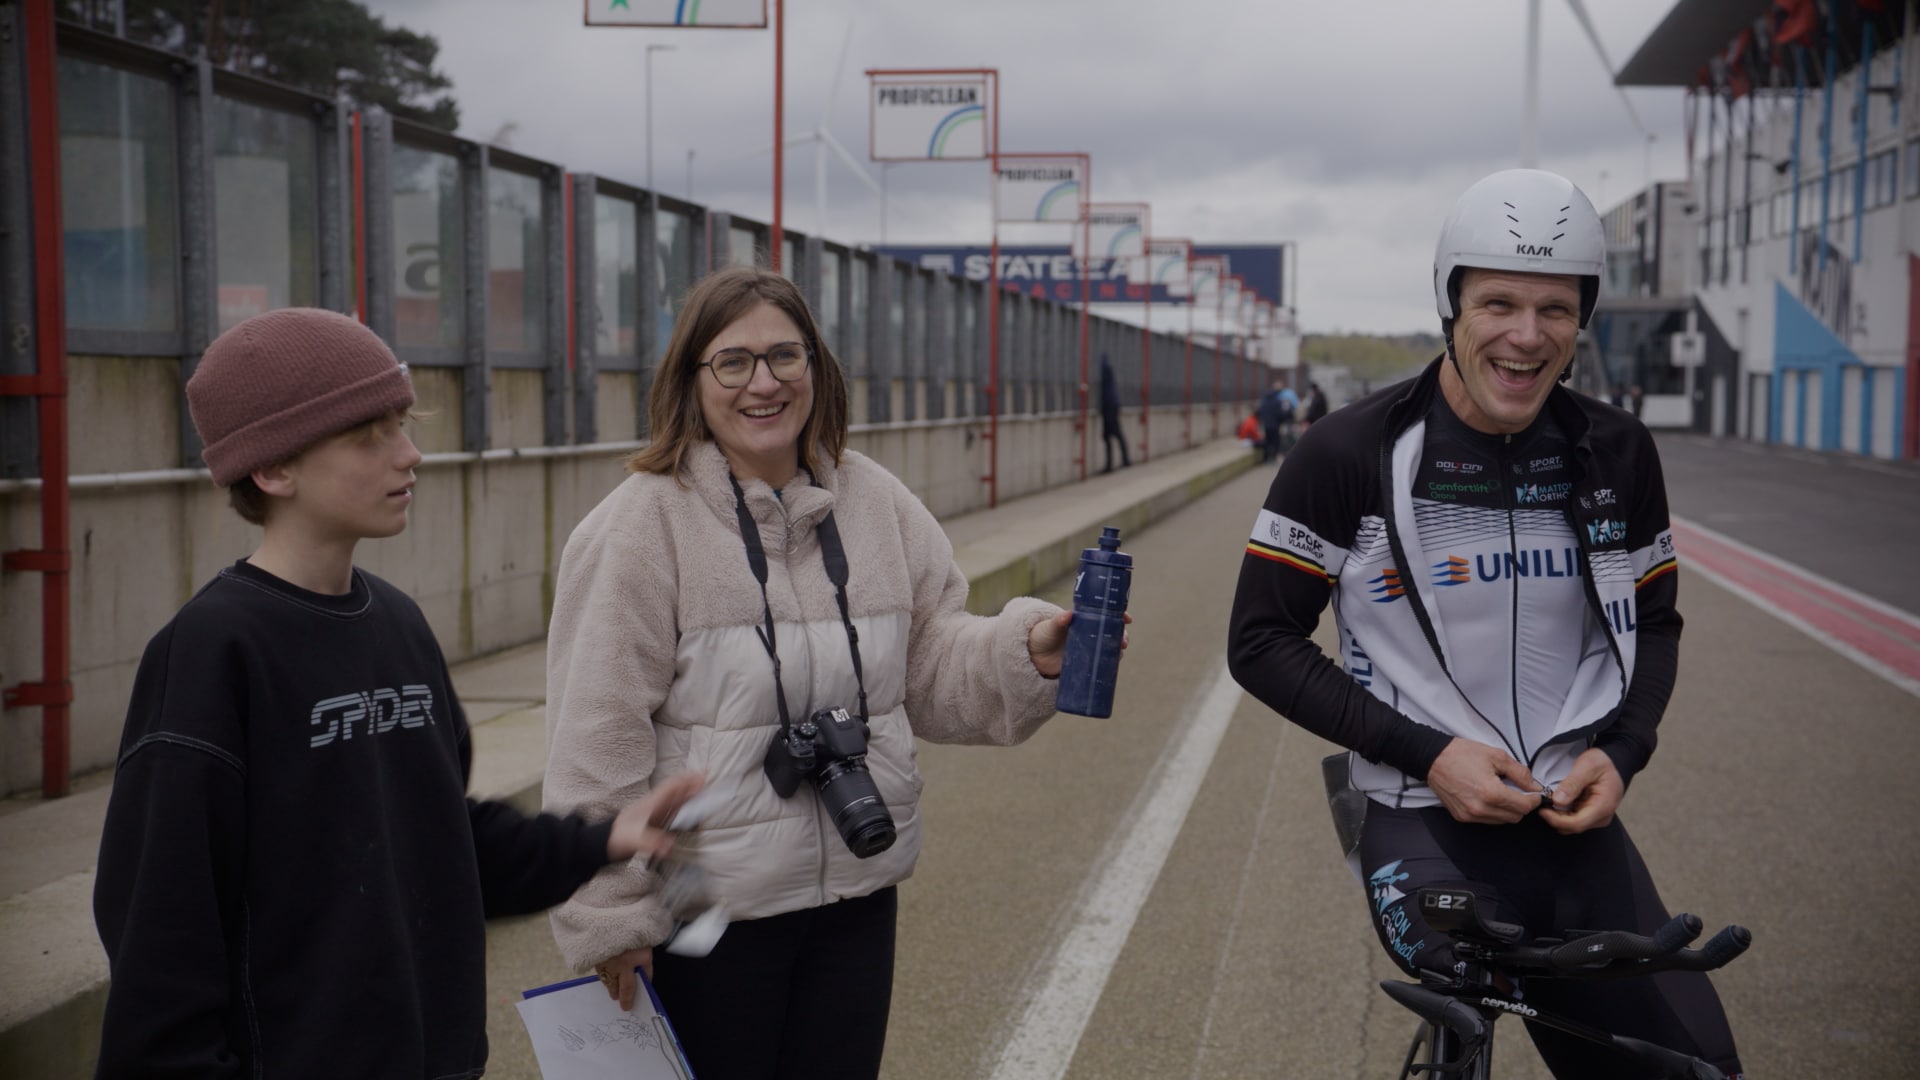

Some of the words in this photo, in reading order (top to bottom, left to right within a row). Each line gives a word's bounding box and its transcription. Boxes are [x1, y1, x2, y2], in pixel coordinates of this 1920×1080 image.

[878, 88, 977, 105] PROFICLEAN
[1516, 244, 1553, 257] KASK
[1428, 480, 1489, 494] Comfortlift
[310, 684, 436, 749] SPYDER
[1425, 894, 1468, 910] D2Z
[1481, 997, 1538, 1017] cervélo
